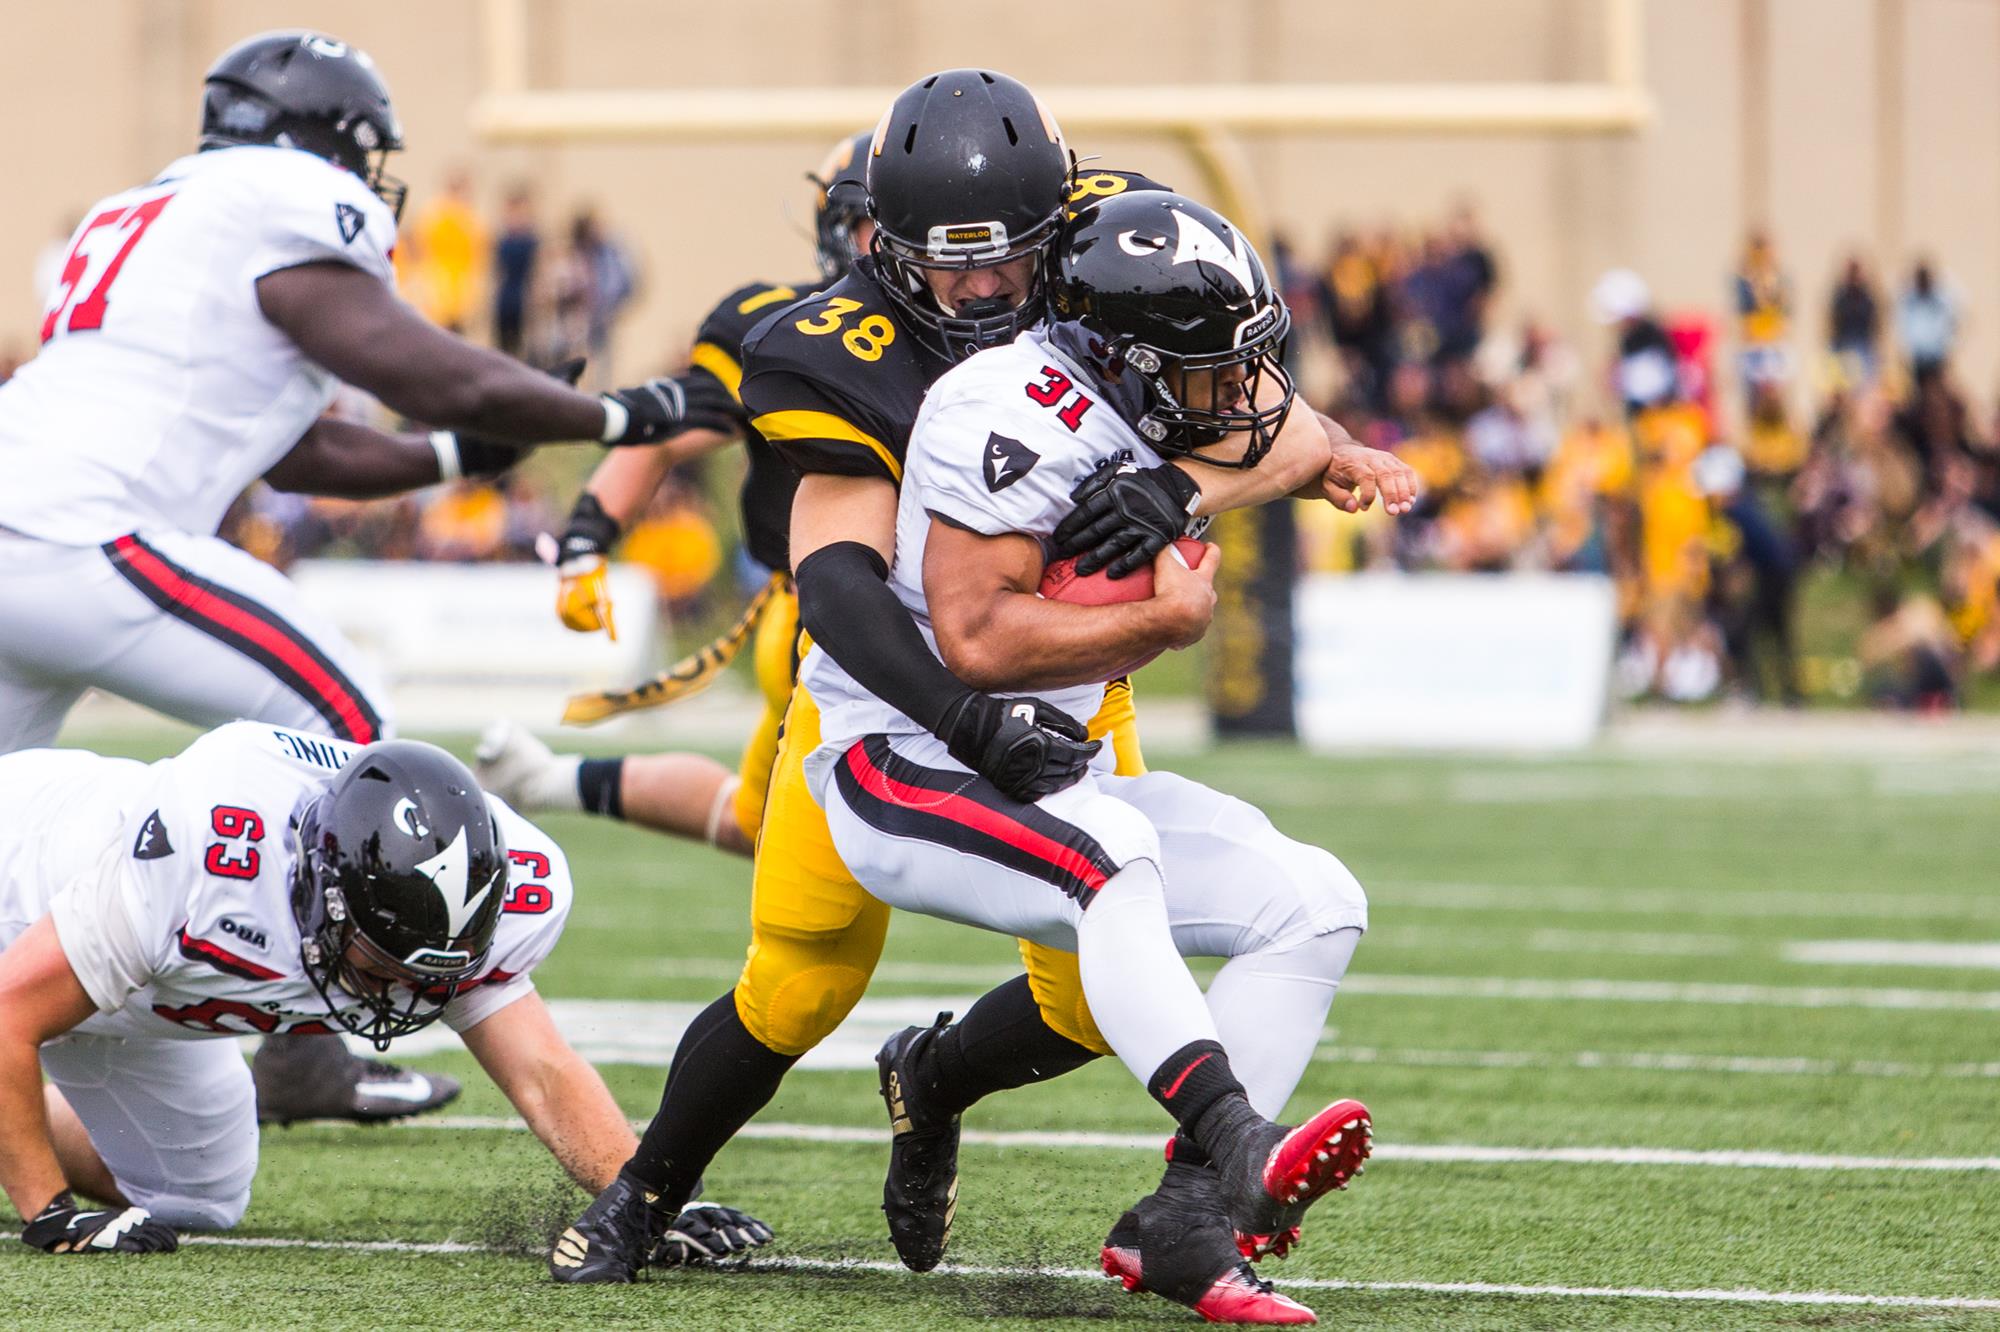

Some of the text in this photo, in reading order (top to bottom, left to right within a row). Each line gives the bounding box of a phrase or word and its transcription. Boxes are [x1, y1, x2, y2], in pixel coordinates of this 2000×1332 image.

[947, 230, 990, 240] WATERLOO
[40, 193, 178, 346] 57
[795, 296, 896, 362] 38
[1024, 365, 1095, 433] 31
[204, 804, 266, 882] 63
[219, 917, 267, 950] OUA
